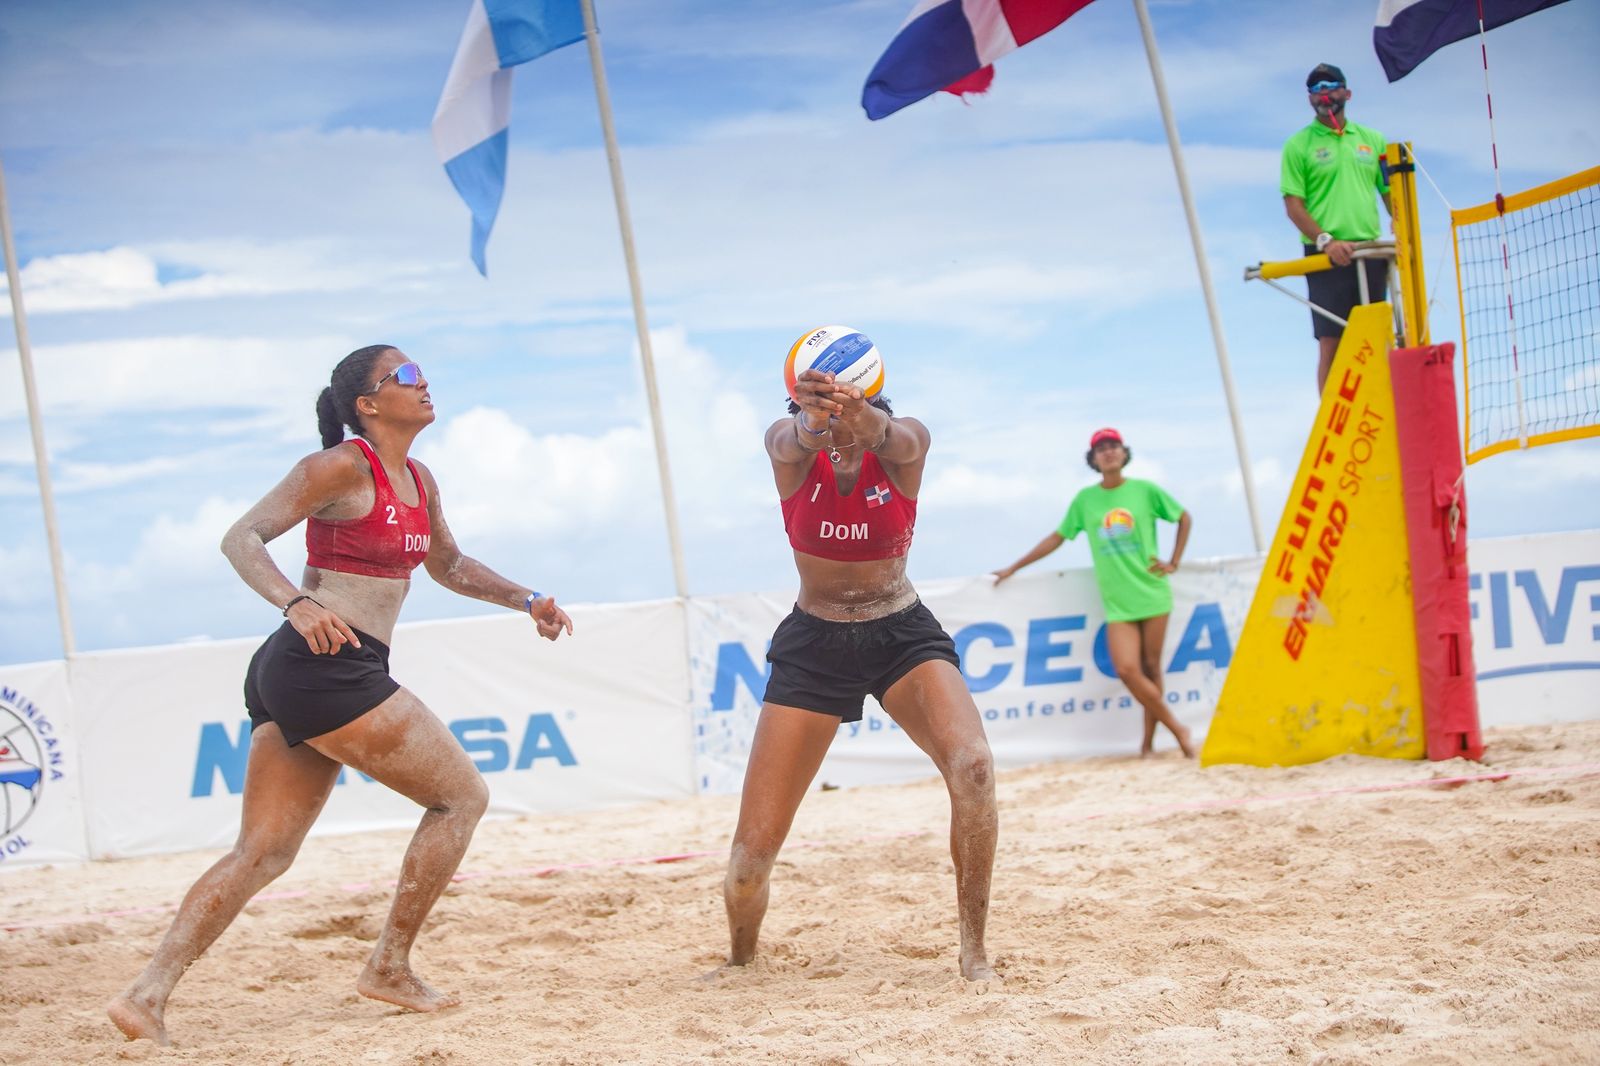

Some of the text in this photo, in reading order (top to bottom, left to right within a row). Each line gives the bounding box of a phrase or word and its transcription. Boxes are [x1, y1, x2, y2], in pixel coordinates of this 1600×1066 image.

[1353, 339, 1375, 365] by
[1338, 403, 1384, 496] SPORT
[811, 483, 822, 502] 1
[385, 505, 398, 525] 2
[819, 521, 869, 540] DOM
[404, 534, 431, 553] DOM
[0, 686, 64, 781] MINICANA
